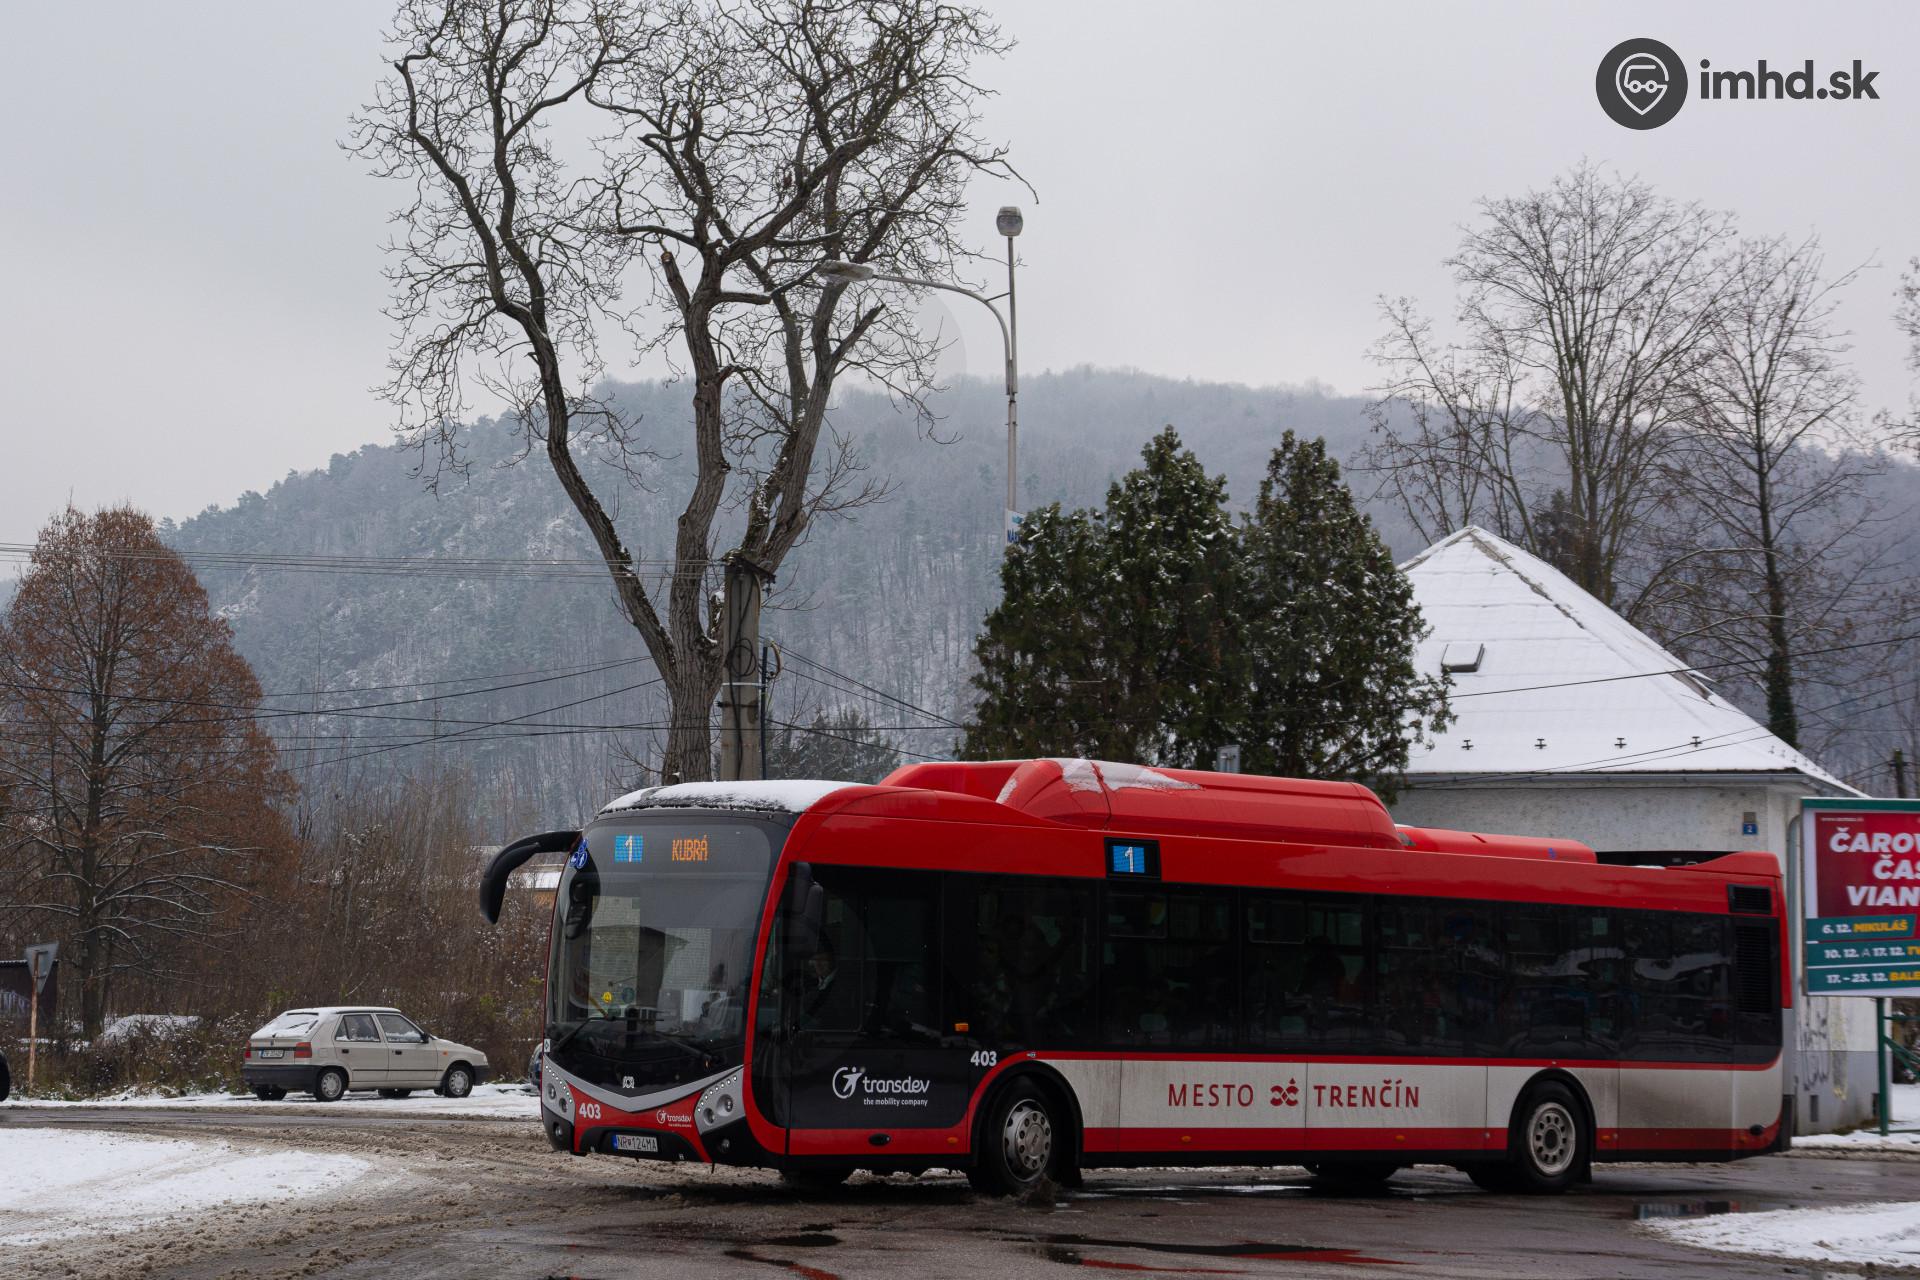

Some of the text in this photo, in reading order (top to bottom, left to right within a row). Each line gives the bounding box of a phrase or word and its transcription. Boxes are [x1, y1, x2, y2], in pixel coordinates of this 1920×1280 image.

[624, 835, 633, 862] 1
[671, 834, 708, 861] KUBRÁ
[1124, 846, 1134, 873] 1
[970, 1050, 997, 1067] 403
[862, 1075, 930, 1093] transdev
[1167, 1078, 1420, 1108] MESTO TRENČÍN
[578, 1102, 601, 1119] 403
[863, 1097, 928, 1107] the mobility company
[667, 1111, 692, 1123] transdev
